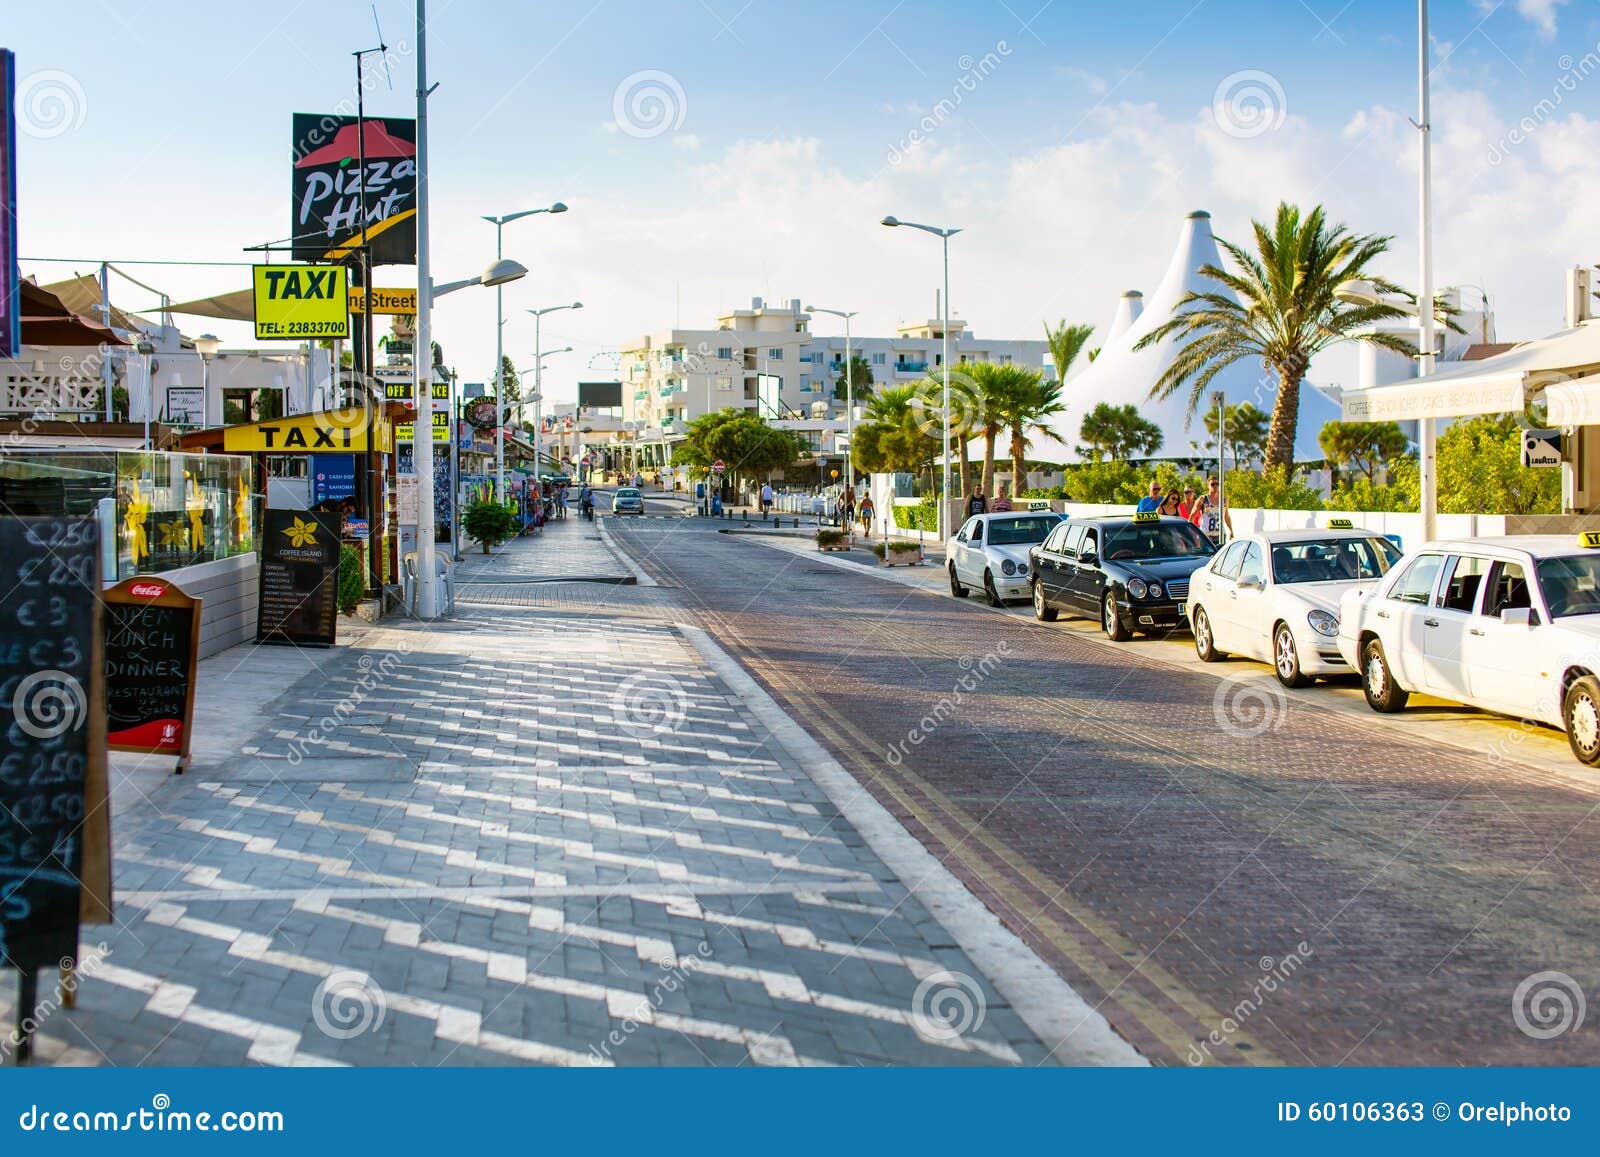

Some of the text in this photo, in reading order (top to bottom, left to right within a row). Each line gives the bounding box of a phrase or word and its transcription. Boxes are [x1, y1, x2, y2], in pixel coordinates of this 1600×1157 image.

[300, 158, 416, 225] Pizza
[323, 188, 410, 237] Hut
[265, 271, 337, 299] TAXI
[259, 321, 345, 334] TEL: 23833700
[387, 385, 405, 397] OFF
[259, 427, 351, 448] TAXI
[1531, 456, 1557, 464] LAVAZZA
[1030, 502, 1048, 510] TAXI
[1138, 512, 1158, 520] TAXI
[279, 549, 322, 558] COFFEE ISLAND
[104, 628, 175, 649] LUNCH
[104, 659, 185, 679] DINNER
